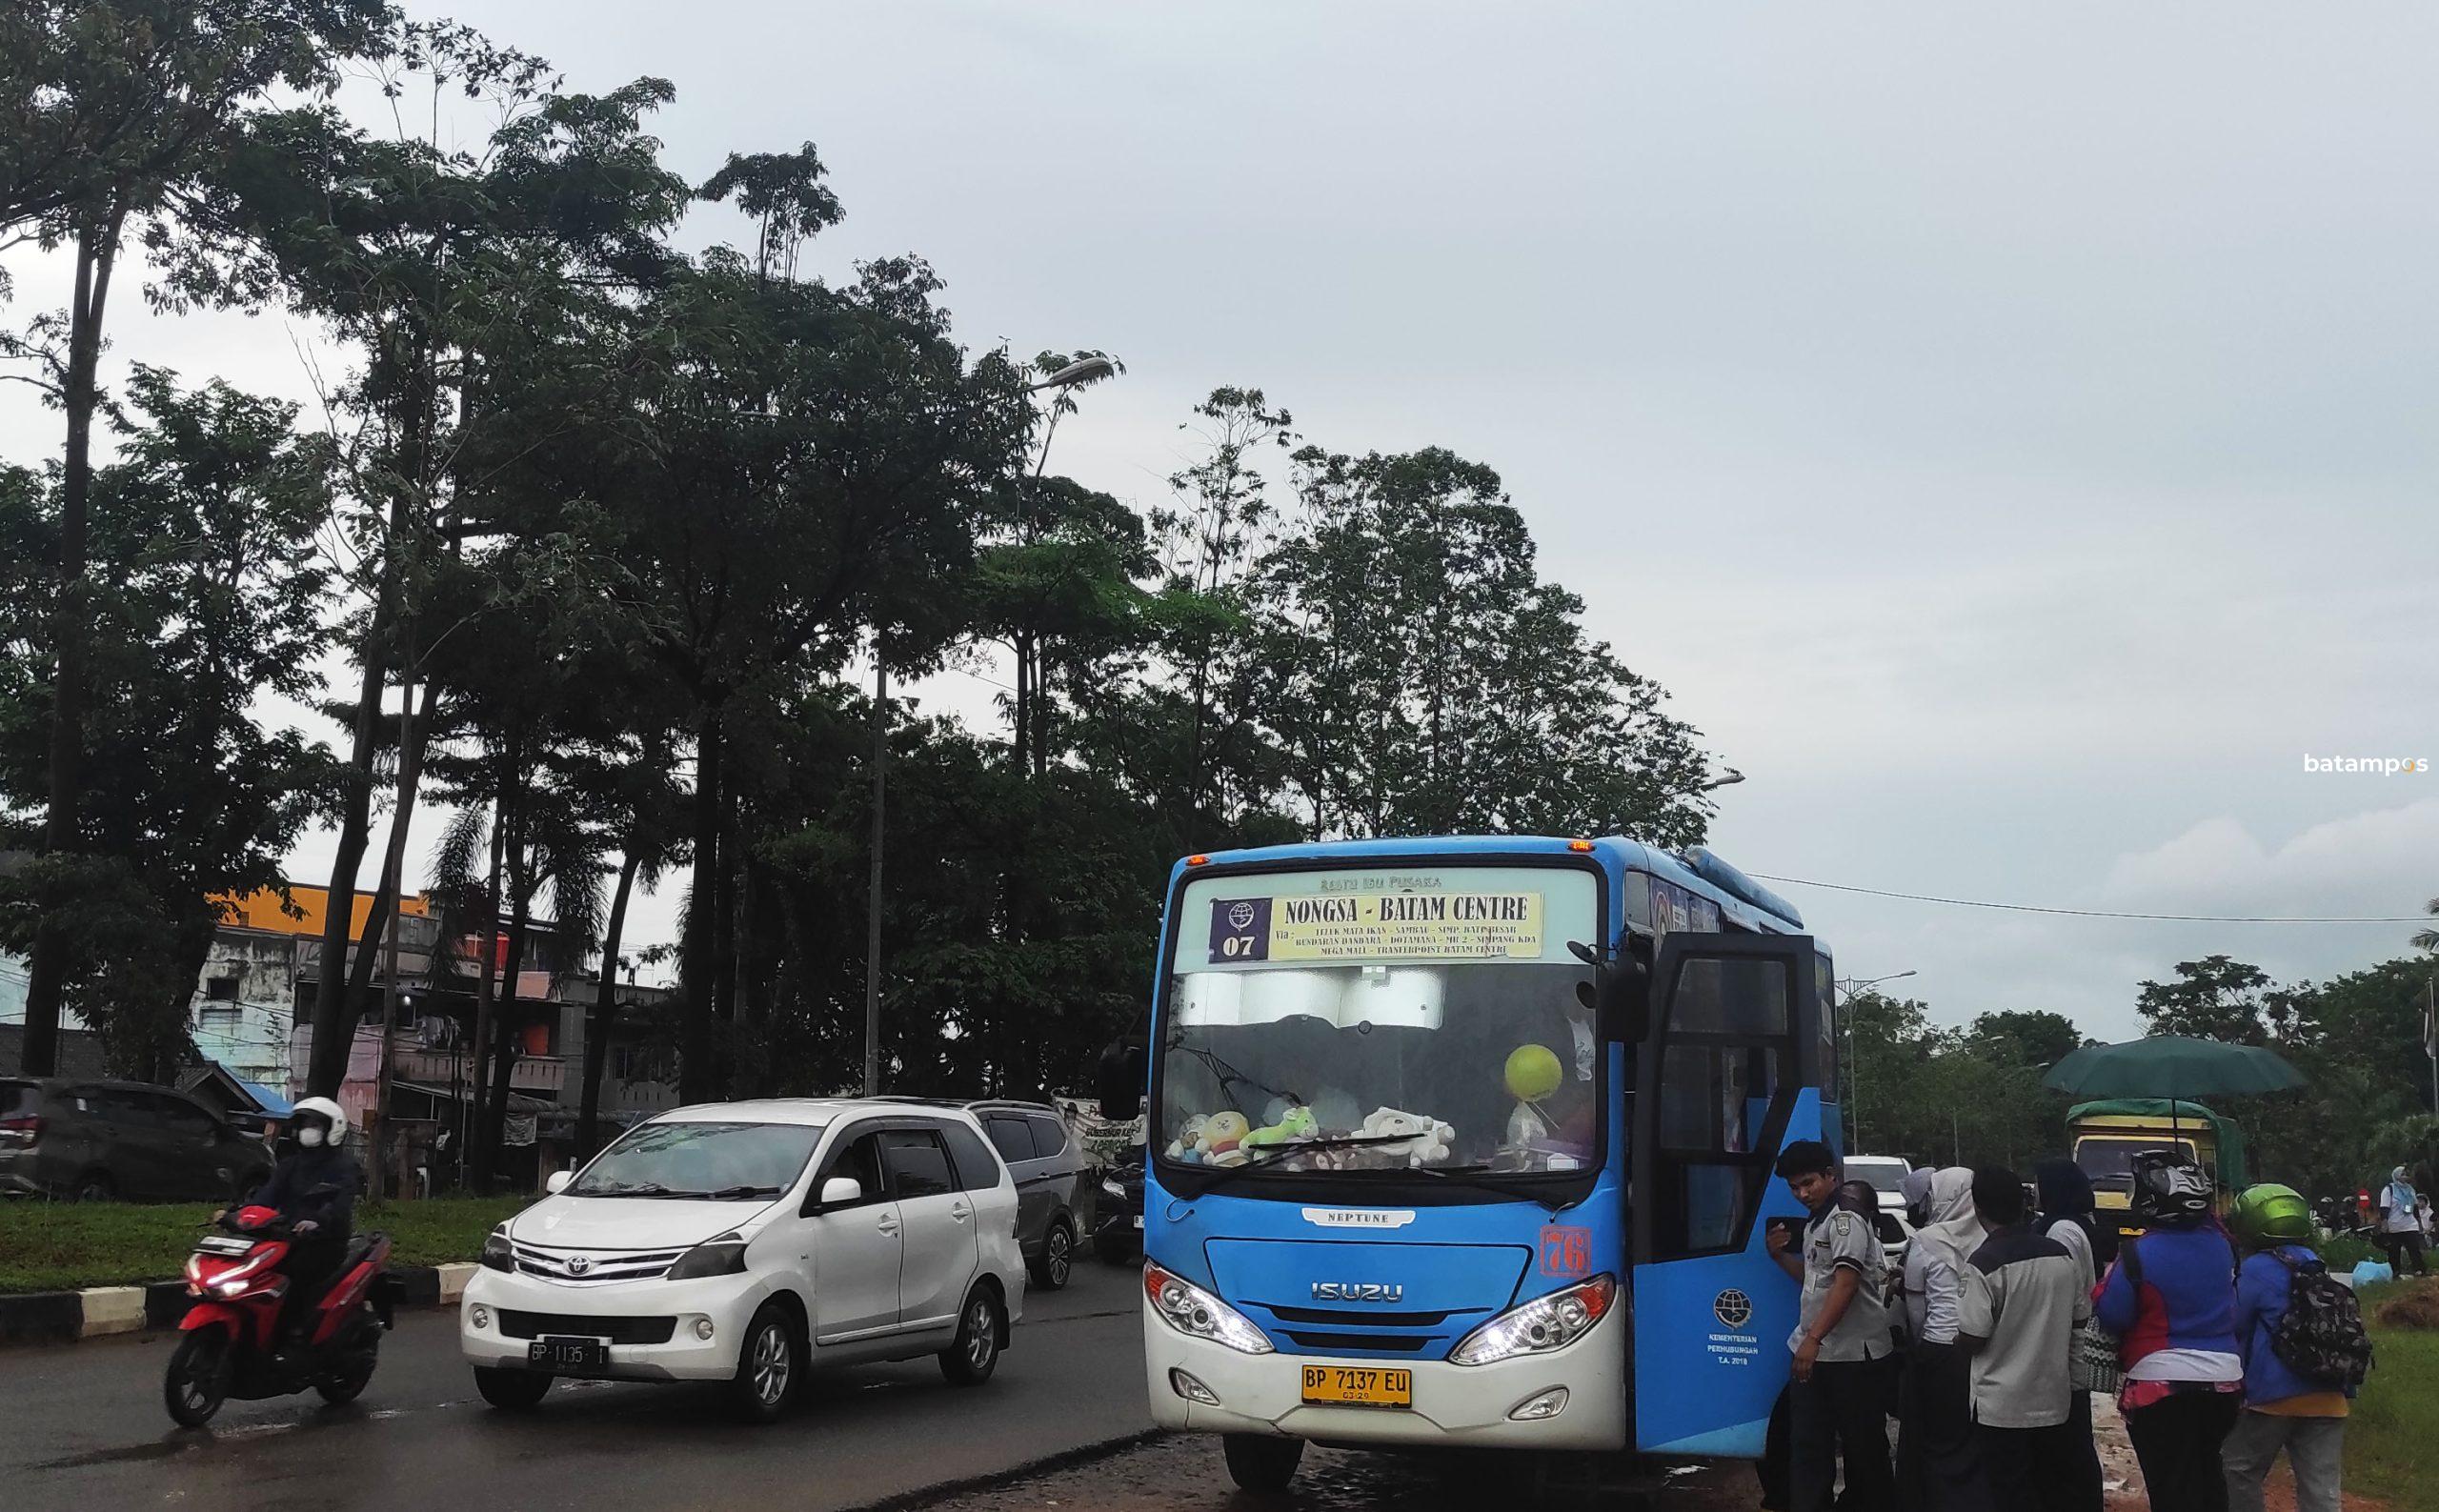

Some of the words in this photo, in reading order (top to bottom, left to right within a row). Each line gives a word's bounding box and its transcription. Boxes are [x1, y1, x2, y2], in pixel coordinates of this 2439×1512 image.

[1285, 898, 1358, 924] NONGSA
[1380, 897, 1445, 921] BATAM
[1453, 896, 1528, 921] CENTRE
[1343, 926, 1363, 936] MATA
[1222, 936, 1256, 957] 07
[1328, 1213, 1389, 1223] NEPTUNE
[1547, 1232, 1586, 1270] 76
[1312, 1281, 1402, 1302] ISUZU
[533, 1344, 547, 1361] BP
[555, 1344, 583, 1363] 1135
[1305, 1369, 1326, 1388] BP
[1336, 1370, 1378, 1390] 7137
[1384, 1372, 1406, 1392] EU
